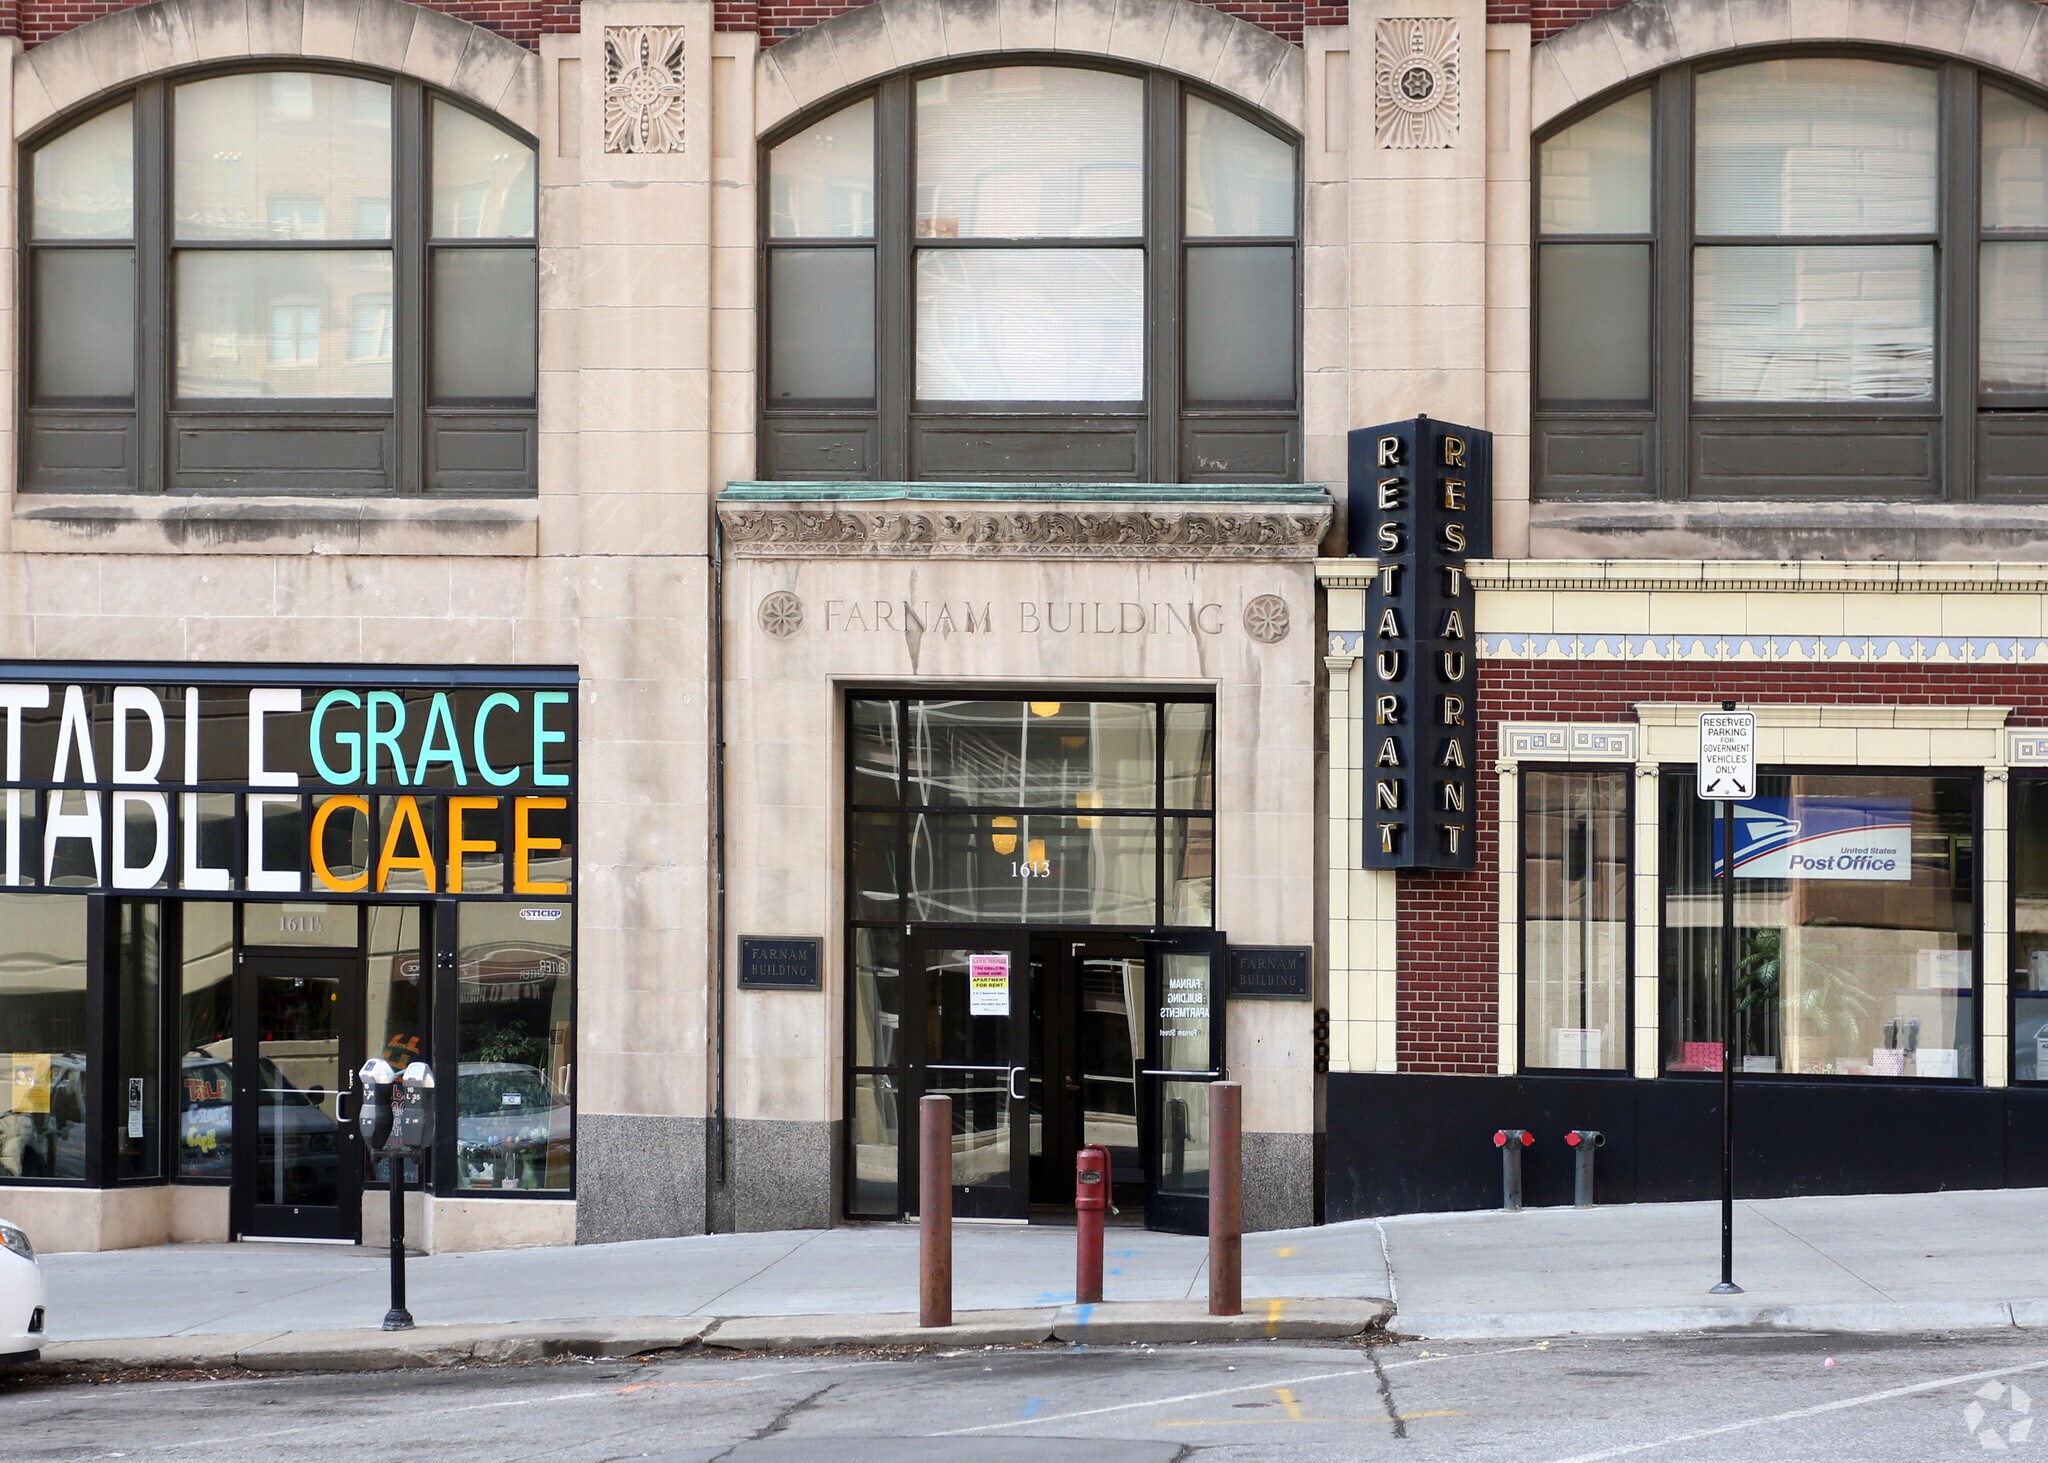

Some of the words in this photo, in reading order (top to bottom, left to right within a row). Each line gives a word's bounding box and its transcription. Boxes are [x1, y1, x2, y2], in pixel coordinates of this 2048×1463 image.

[823, 599, 993, 635] FARNAM
[1018, 601, 1226, 636] BUILDING
[1376, 435, 1401, 854] RESTAURANT
[1444, 434, 1467, 856] RESTAURANT
[1703, 718, 1751, 727] RESERVED
[309, 689, 570, 787] GRACE
[1708, 728, 1747, 737] PARKING
[1703, 744, 1750, 753] GOVERNMENT
[1706, 755, 1748, 763] VEHICLES
[1715, 765, 1738, 774] ONLY
[309, 794, 568, 894] CAFE
[1789, 854, 1835, 871] Post
[1836, 854, 1896, 872] Office
[1011, 861, 1051, 878] 1613
[752, 948, 808, 960] FARNAM
[1240, 958, 1297, 970] FARNAM
[751, 964, 808, 977] BUILDING
[1239, 974, 1297, 986] BUILDING
[412, 1093, 421, 1101] 35
[405, 1117, 410, 1125] 2
